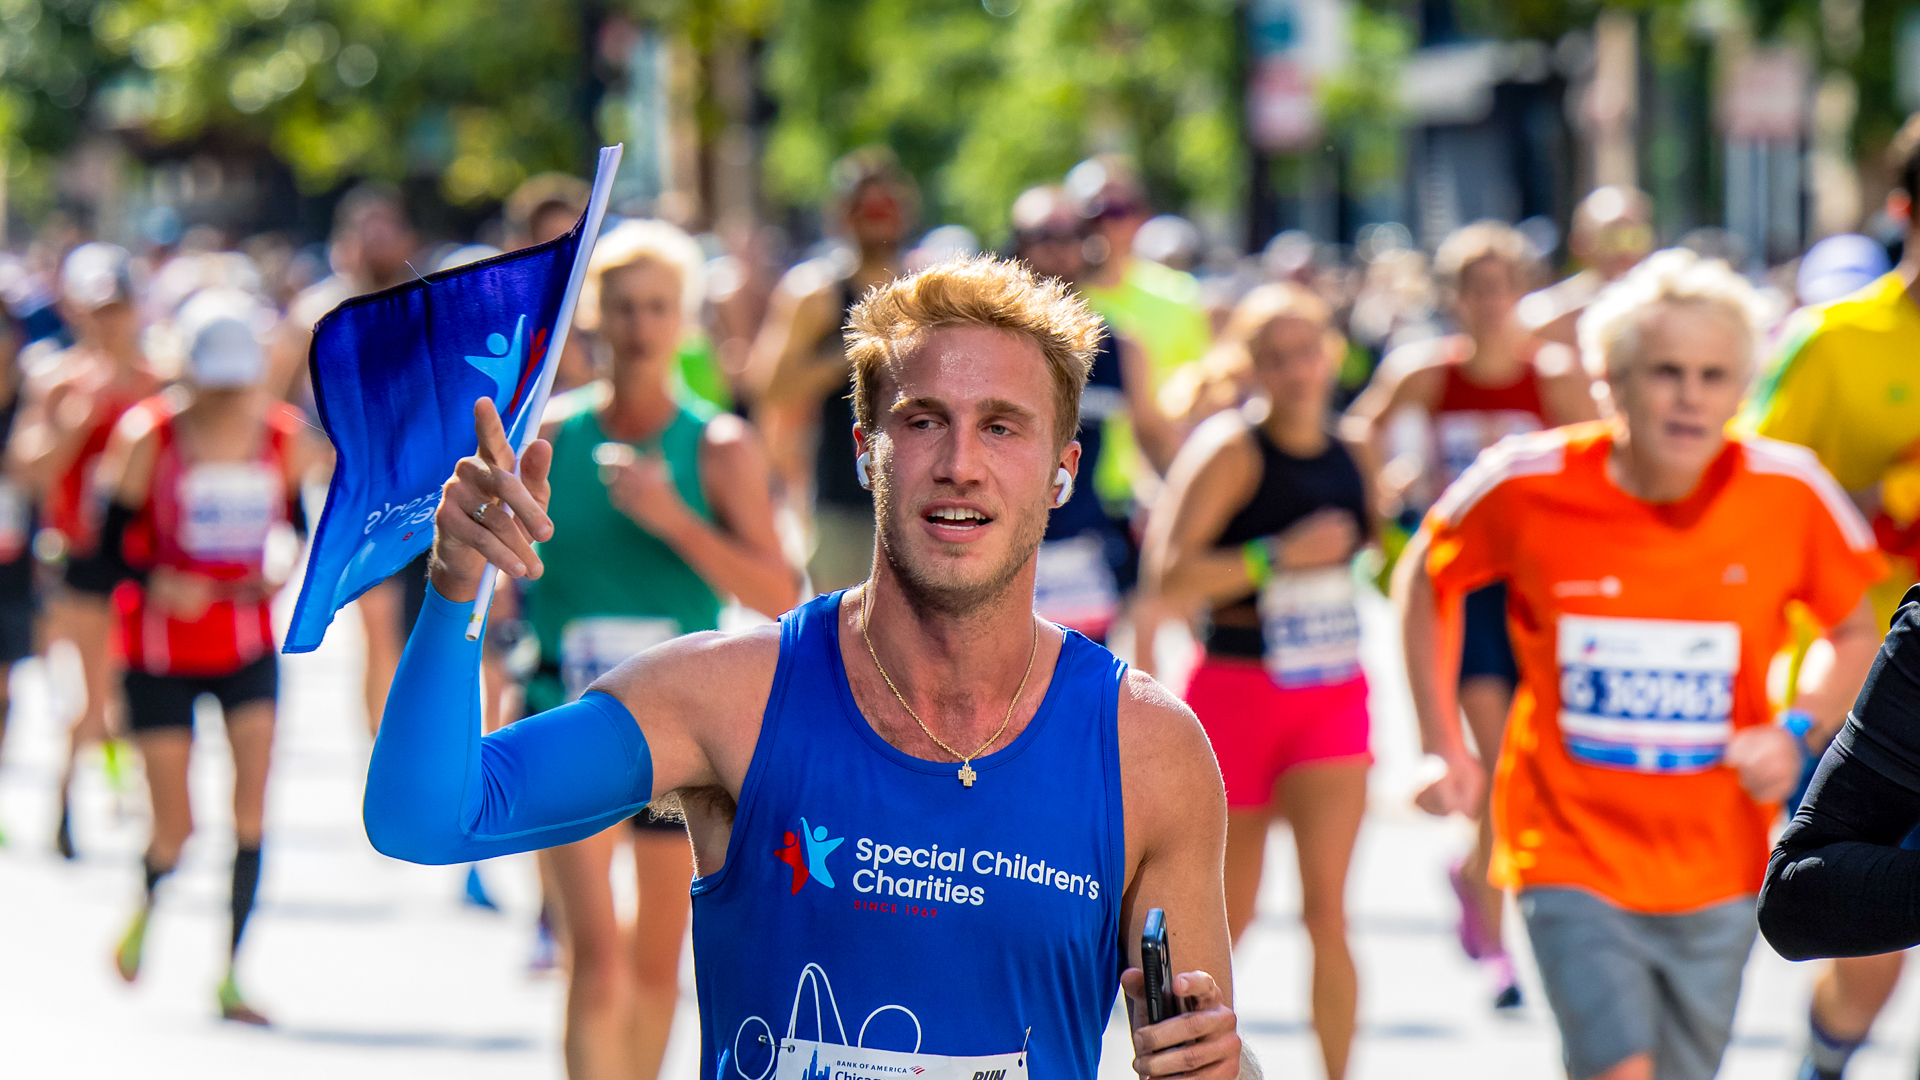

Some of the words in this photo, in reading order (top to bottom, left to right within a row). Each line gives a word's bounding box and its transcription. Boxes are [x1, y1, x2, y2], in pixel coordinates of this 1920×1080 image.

[855, 838, 966, 872] Special
[971, 850, 1100, 900] Children's
[852, 869, 985, 906] Charities
[853, 899, 897, 914] SINCE
[905, 904, 938, 918] 1969
[836, 1060, 858, 1068] BANK
[870, 1064, 907, 1073] AMERICA
